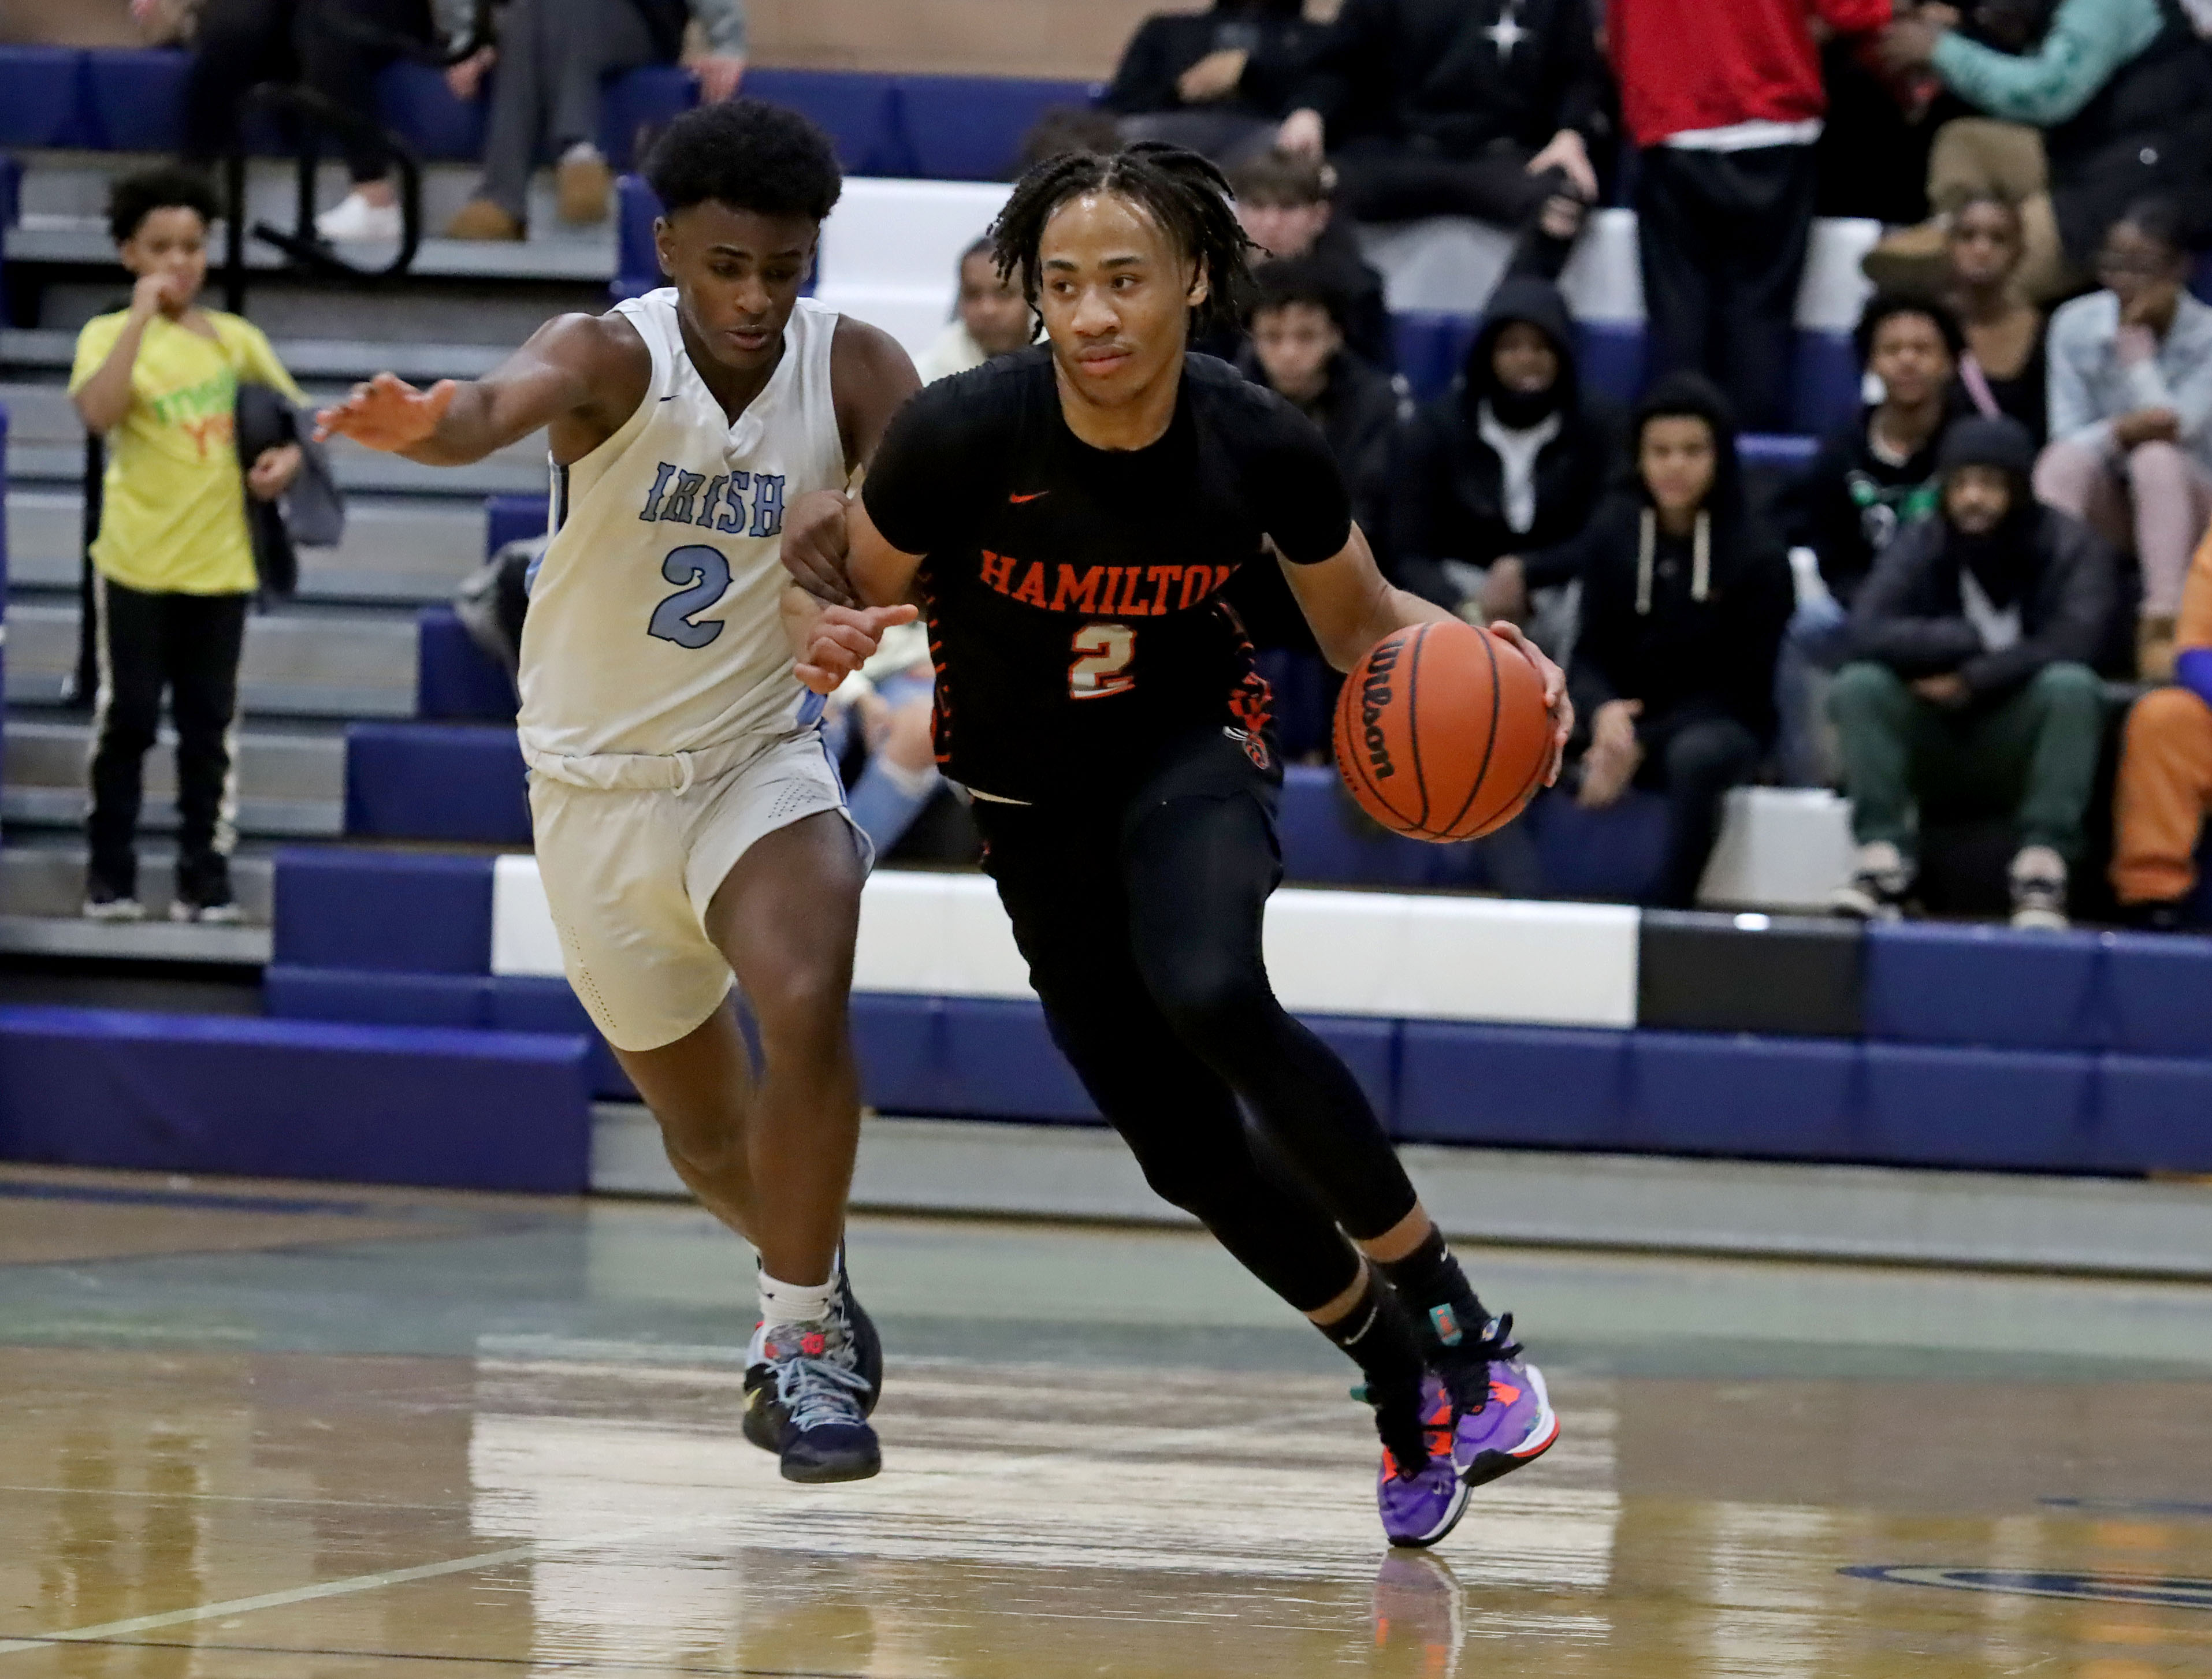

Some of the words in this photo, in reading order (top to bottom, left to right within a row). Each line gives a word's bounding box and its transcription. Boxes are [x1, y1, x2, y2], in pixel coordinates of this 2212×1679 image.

[639, 461, 785, 537] IRISH
[647, 544, 734, 649] 2
[1068, 623, 1136, 699] 2
[1363, 638, 1406, 781] Wilson
